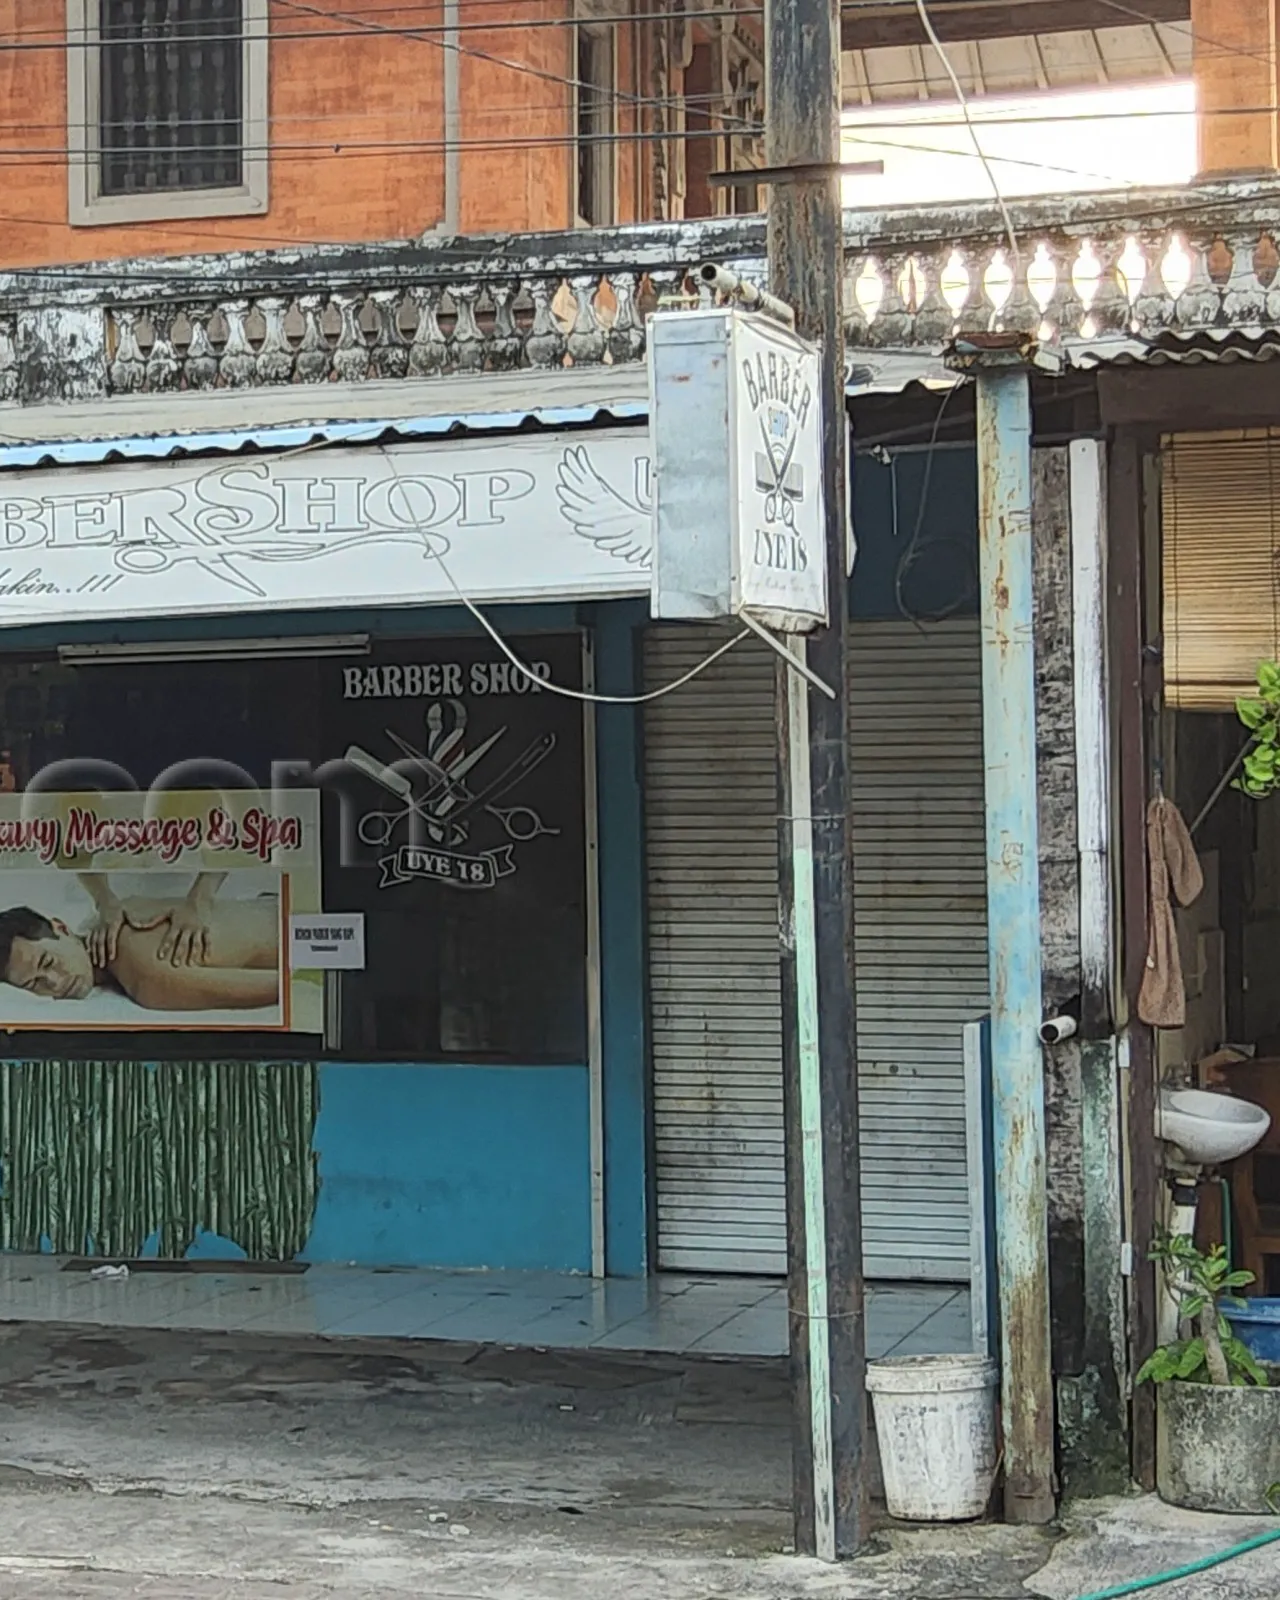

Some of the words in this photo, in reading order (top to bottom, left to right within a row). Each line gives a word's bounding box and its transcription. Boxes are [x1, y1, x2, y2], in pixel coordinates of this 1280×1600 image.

[742, 351, 811, 430] BARBER
[343, 663, 464, 699] BARBER
[471, 661, 551, 695] SHOP
[65, 806, 201, 866] Massage
[206, 806, 237, 852] &
[242, 807, 302, 863] Spa
[407, 851, 452, 876] UYE
[459, 861, 485, 882] 18
